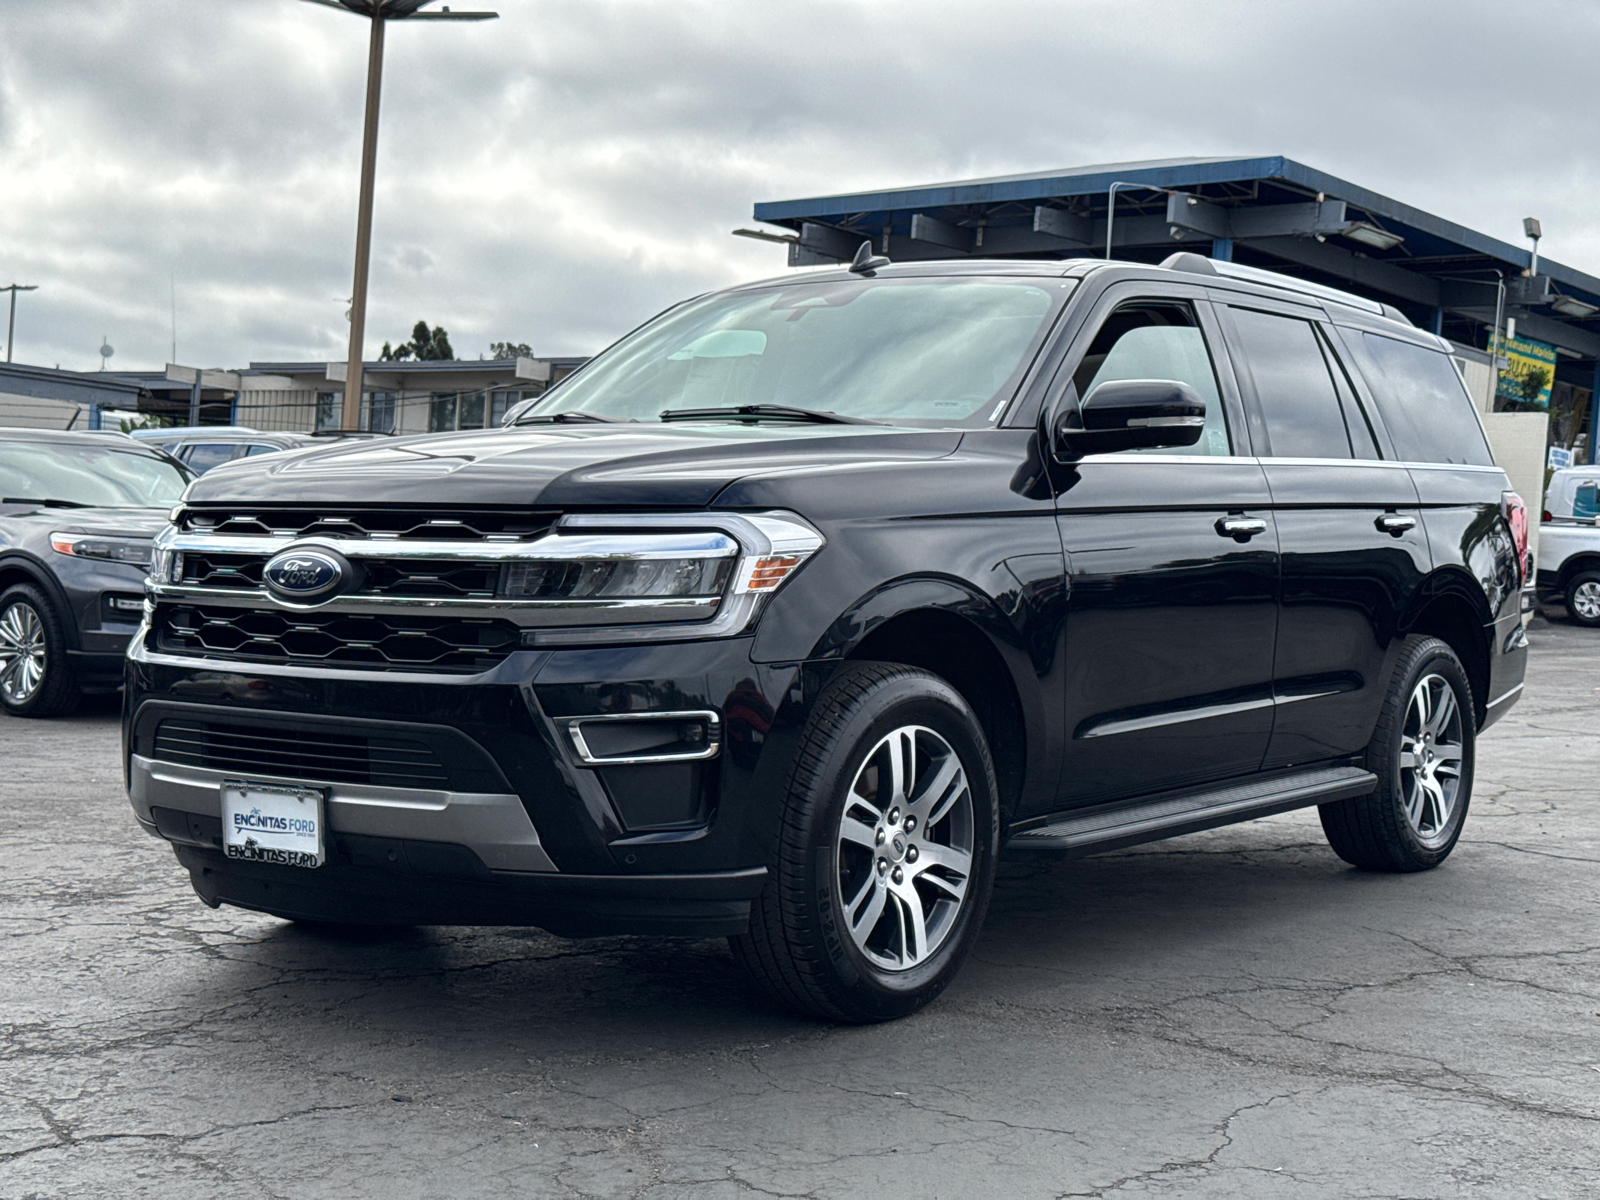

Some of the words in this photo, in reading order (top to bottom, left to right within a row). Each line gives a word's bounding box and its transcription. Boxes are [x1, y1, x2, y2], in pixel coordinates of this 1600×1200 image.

[279, 559, 321, 585] Ford
[234, 813, 287, 829] ENCINITAS
[289, 819, 315, 832] FORD
[228, 845, 287, 863] ENCINITAS
[287, 851, 318, 868] FORD
